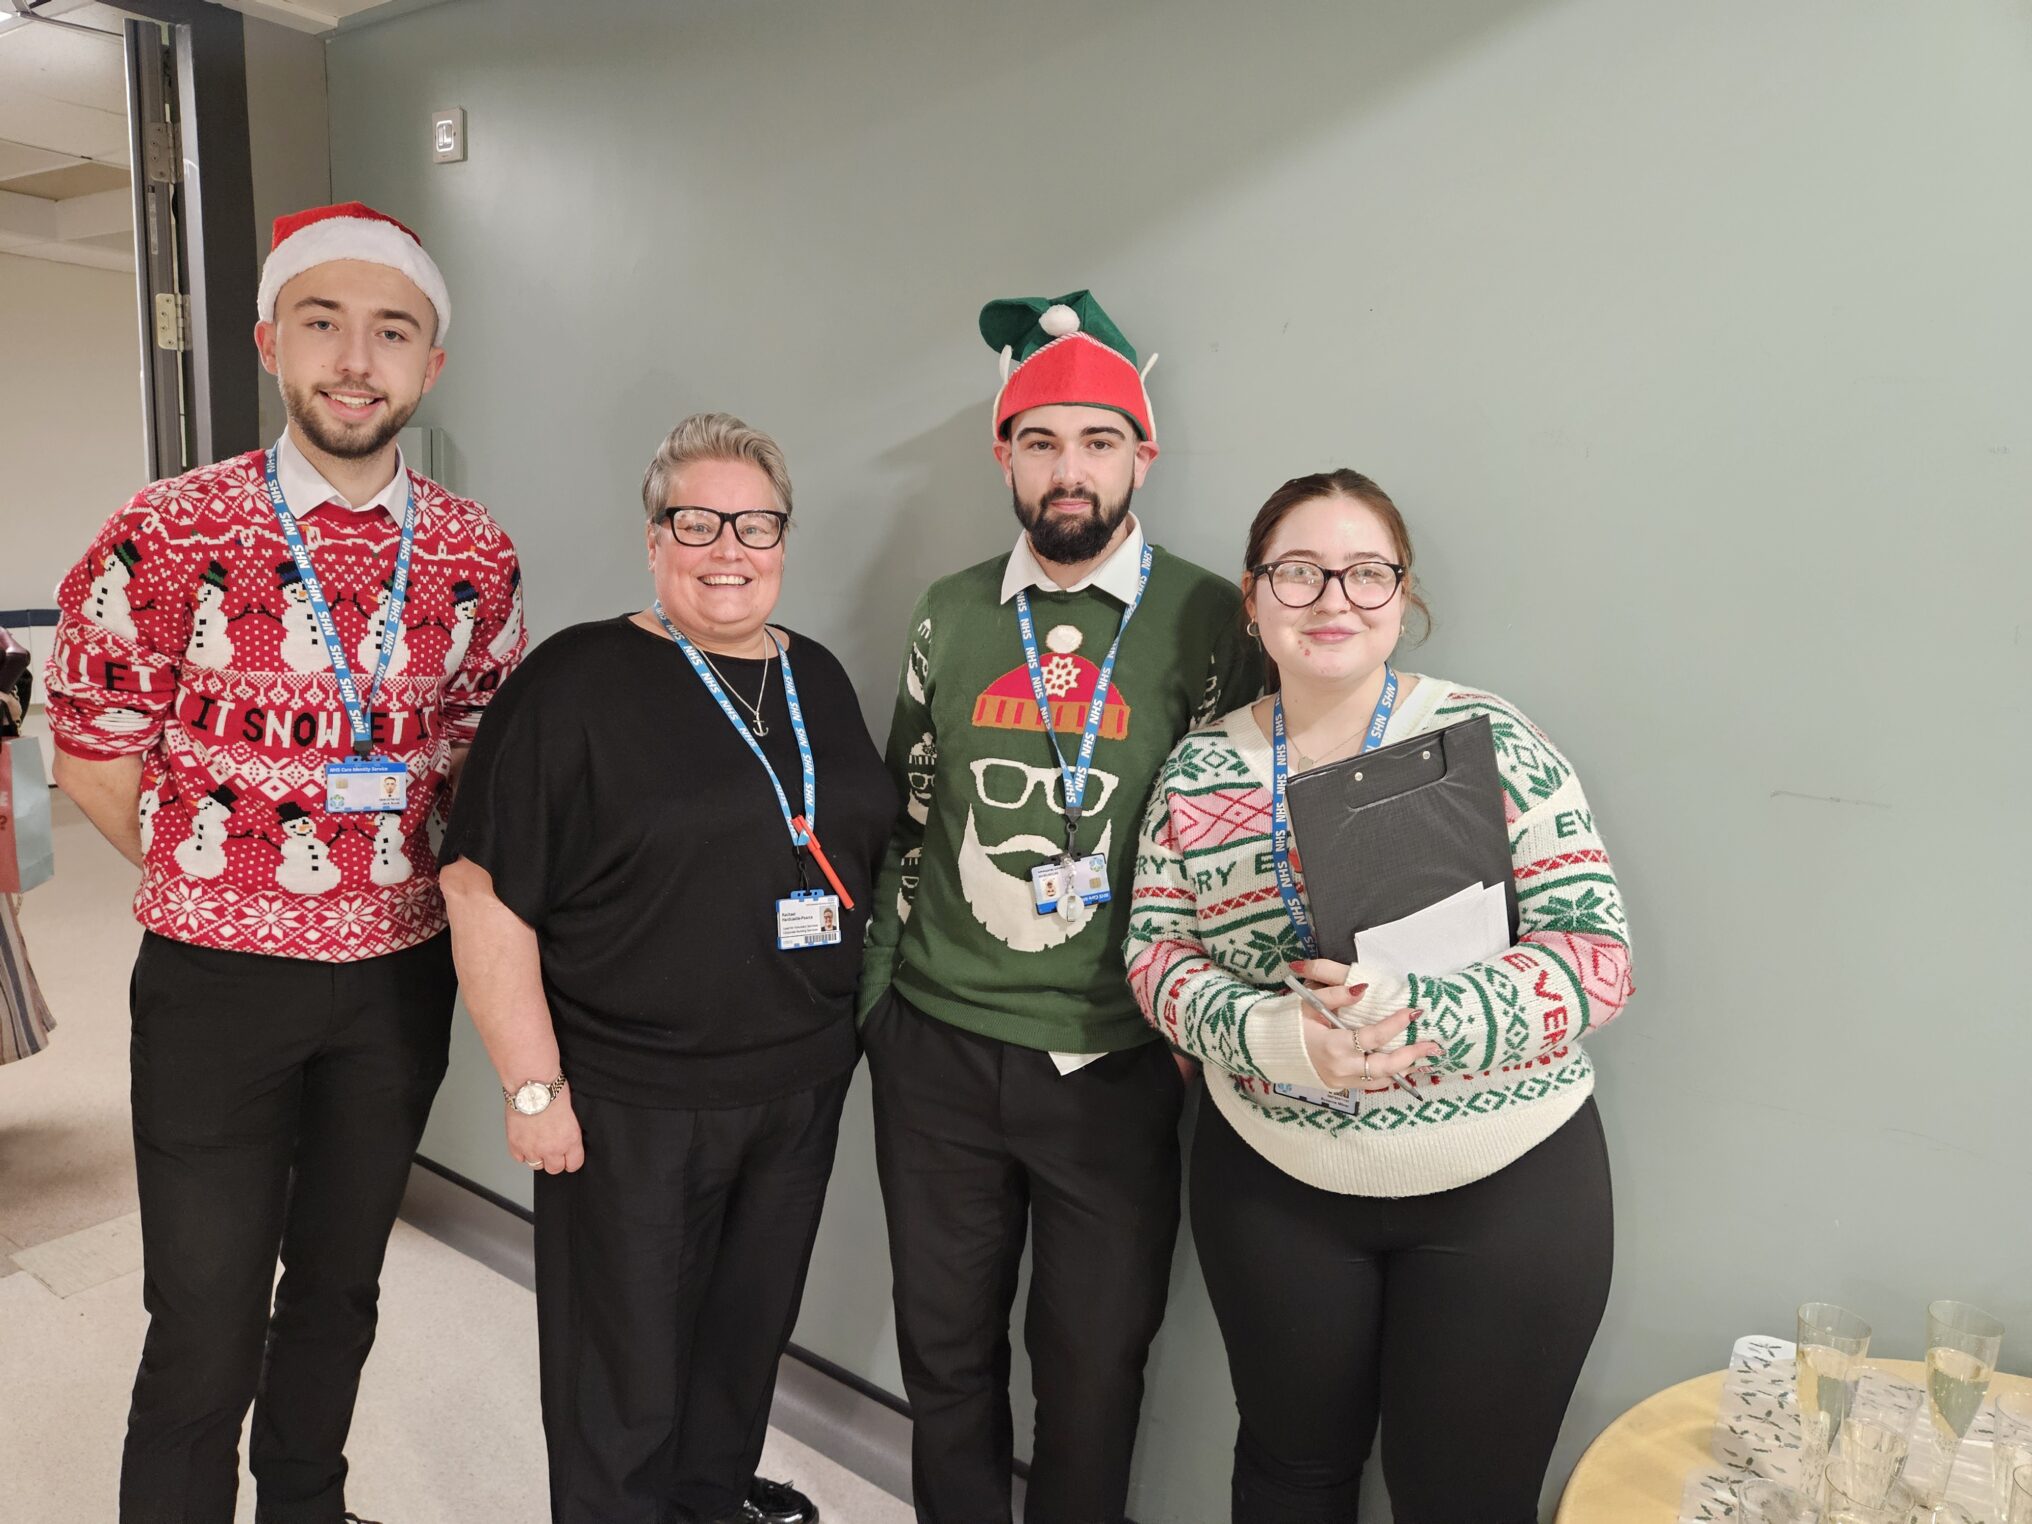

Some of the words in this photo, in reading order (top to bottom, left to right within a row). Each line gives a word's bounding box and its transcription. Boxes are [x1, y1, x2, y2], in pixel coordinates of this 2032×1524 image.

[400, 536, 412, 561] NHS
[1142, 550, 1153, 570] NHS
[394, 566, 407, 592] NHS
[268, 479, 284, 504] NHS
[279, 511, 298, 536] NHS
[292, 544, 310, 569] NHS
[305, 577, 323, 602] NHS
[318, 611, 336, 636] NHS
[329, 645, 346, 669] NHS
[340, 678, 356, 703] NHS
[349, 709, 366, 733] NHS
[389, 598, 402, 624] NHS
[1020, 618, 1032, 640] NHS
[382, 630, 395, 656] NHS
[1025, 647, 1038, 669] NHS
[665, 624, 686, 640] NHS
[683, 645, 703, 666] NHS
[702, 672, 721, 694] NHS
[720, 700, 738, 721] NHS
[1097, 667, 1111, 691] NHS
[784, 675, 796, 695] NHS
[1032, 676, 1044, 699] NHS
[1382, 682, 1396, 708] NHS
[191, 696, 236, 737] IT
[242, 707, 341, 749] SNOW
[351, 712, 409, 746] ET
[415, 705, 436, 740] IT
[790, 702, 801, 721] NHS
[1040, 706, 1051, 730] NHS
[1089, 698, 1103, 725] NHS
[796, 727, 808, 747] NHS
[1276, 713, 1284, 737] NHS
[1370, 713, 1387, 739] NHS
[1080, 732, 1095, 758] NHS
[1277, 744, 1287, 767] NHS
[802, 753, 814, 775] NHS
[1063, 778, 1077, 803] NHS
[1075, 765, 1087, 792] NHS
[1276, 773, 1288, 795] NHS
[805, 783, 814, 806] NHS
[1275, 802, 1287, 823] NHS
[1275, 830, 1286, 852] NHS
[1277, 861, 1293, 887] NHS
[1287, 898, 1308, 925] NHS
